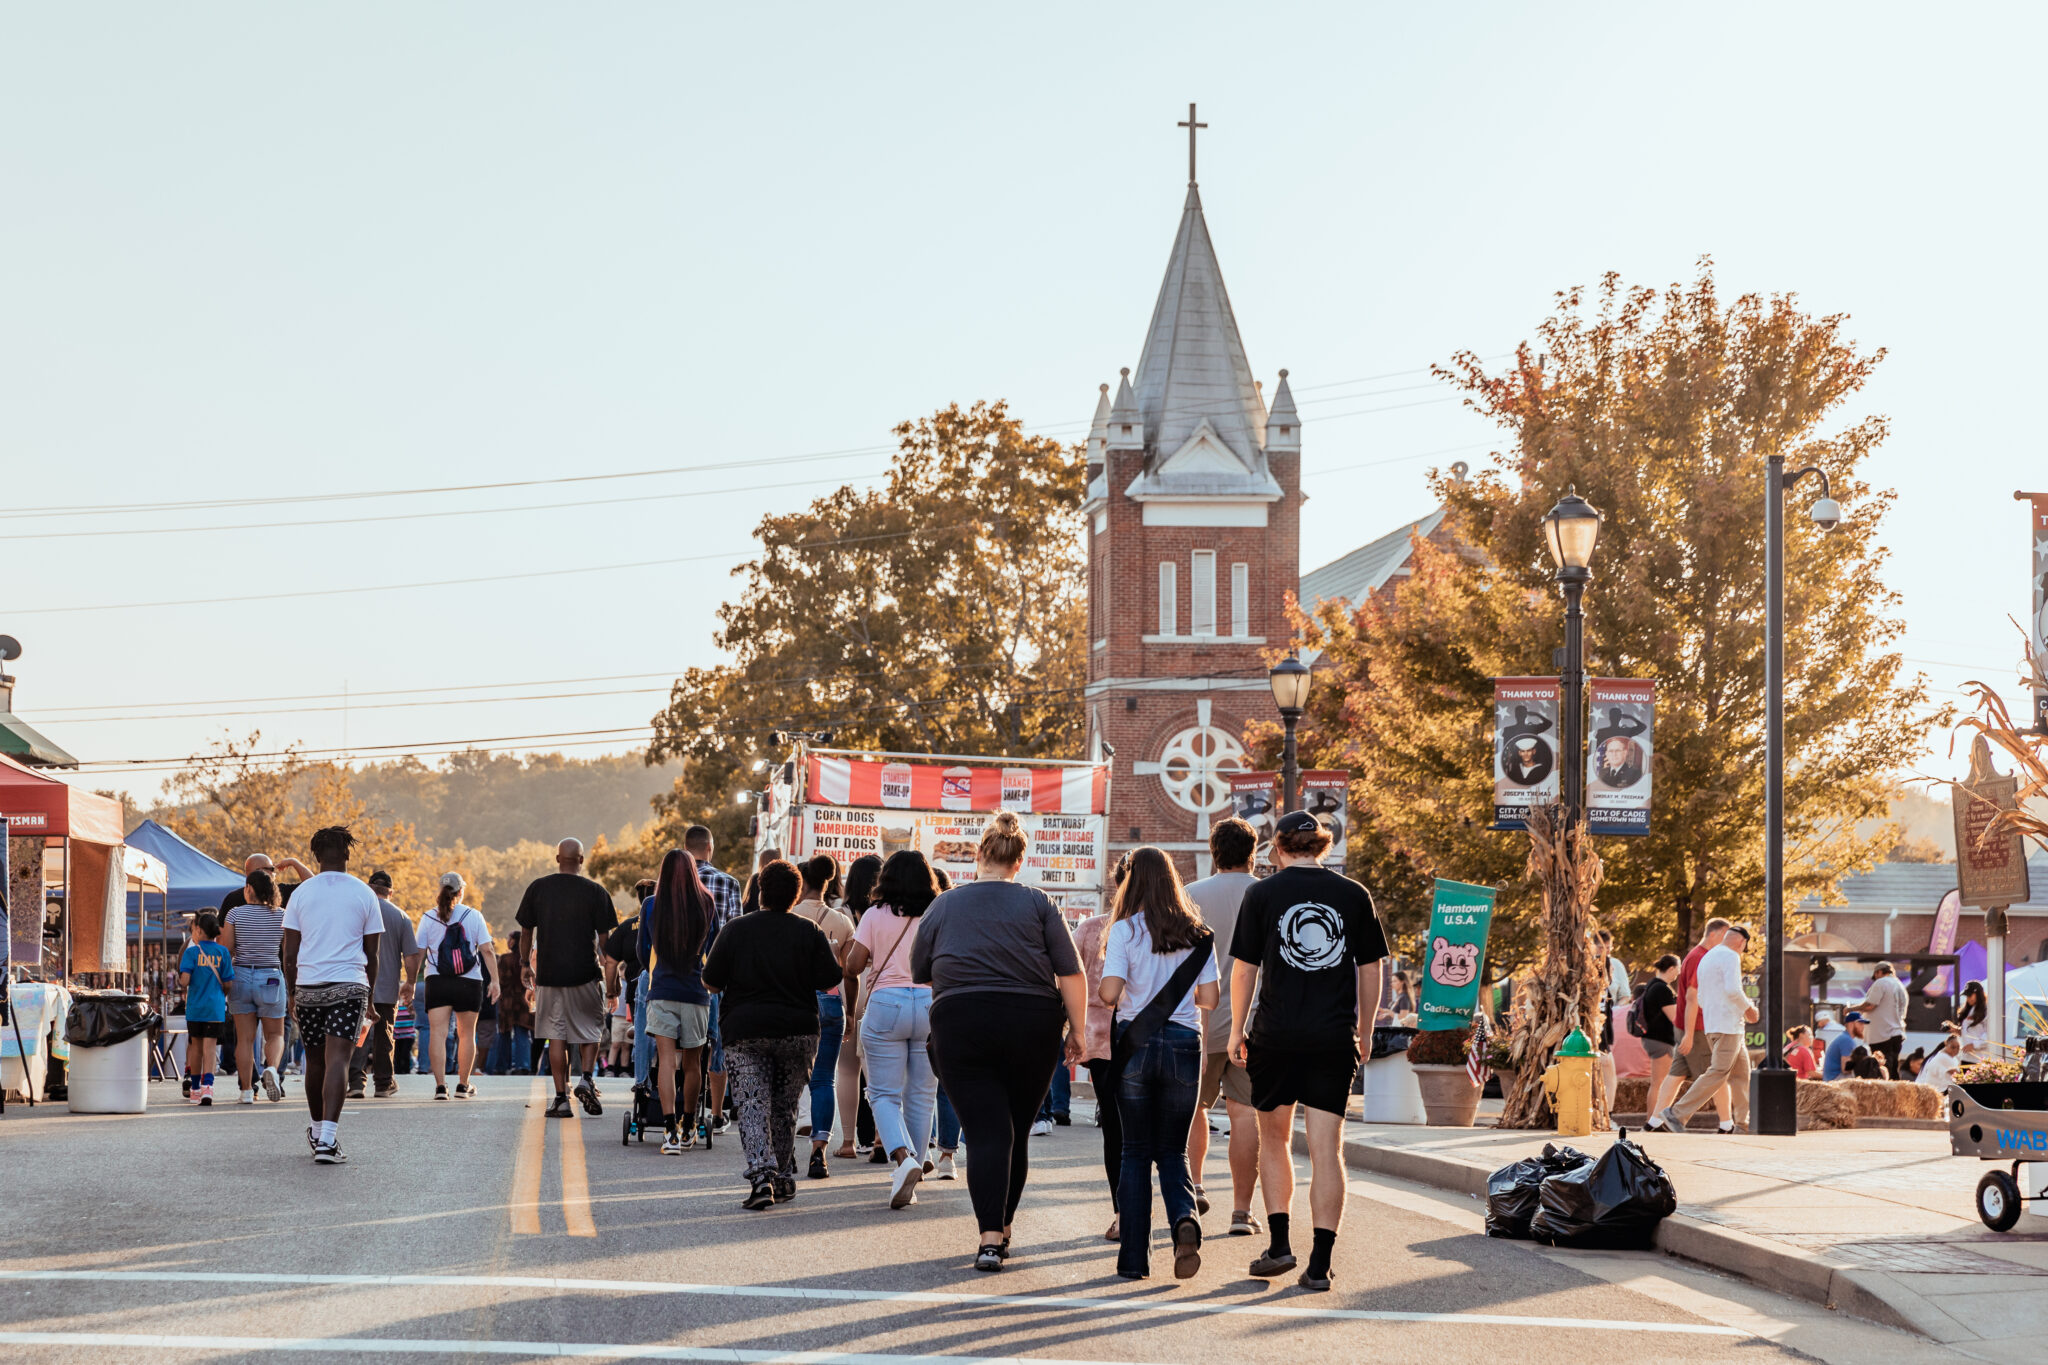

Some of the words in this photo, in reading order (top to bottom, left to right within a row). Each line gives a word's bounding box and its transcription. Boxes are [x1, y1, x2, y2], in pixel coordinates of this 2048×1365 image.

[1502, 690, 1533, 698] THANK
[1534, 690, 1554, 698] YOU
[1596, 692, 1628, 701] THANK
[1630, 694, 1650, 702] YOU
[1004, 777, 1030, 788] ORANGE
[883, 784, 910, 798] SHAKE-UP
[1003, 790, 1030, 801] SHAKE-UP
[816, 810, 842, 822] CORN
[846, 811, 875, 822] DOGS
[1622, 810, 1646, 818] CADIZ
[10, 816, 44, 826] TSMAN
[1042, 818, 1086, 829] BRATWURST
[814, 822, 878, 836] HAMBURGERS
[964, 828, 985, 836] SHAKE-
[1034, 830, 1060, 841] ITALIAN
[1062, 830, 1094, 842] SAUSAGE
[816, 836, 840, 848] HOT
[844, 838, 876, 850] DOGS
[1036, 844, 1060, 854] POLISH
[1062, 844, 1094, 856] SAUSAGE
[1027, 857, 1049, 868] PHILLY
[1049, 856, 1073, 870] CHEESE
[1075, 858, 1096, 870] STEAK
[1041, 870, 1062, 882] SWEET
[1064, 871, 1076, 882] TEA
[1437, 904, 1488, 914] Hamtown
[1444, 915, 1477, 926] U.S.A.
[1455, 1008, 1471, 1016] KY
